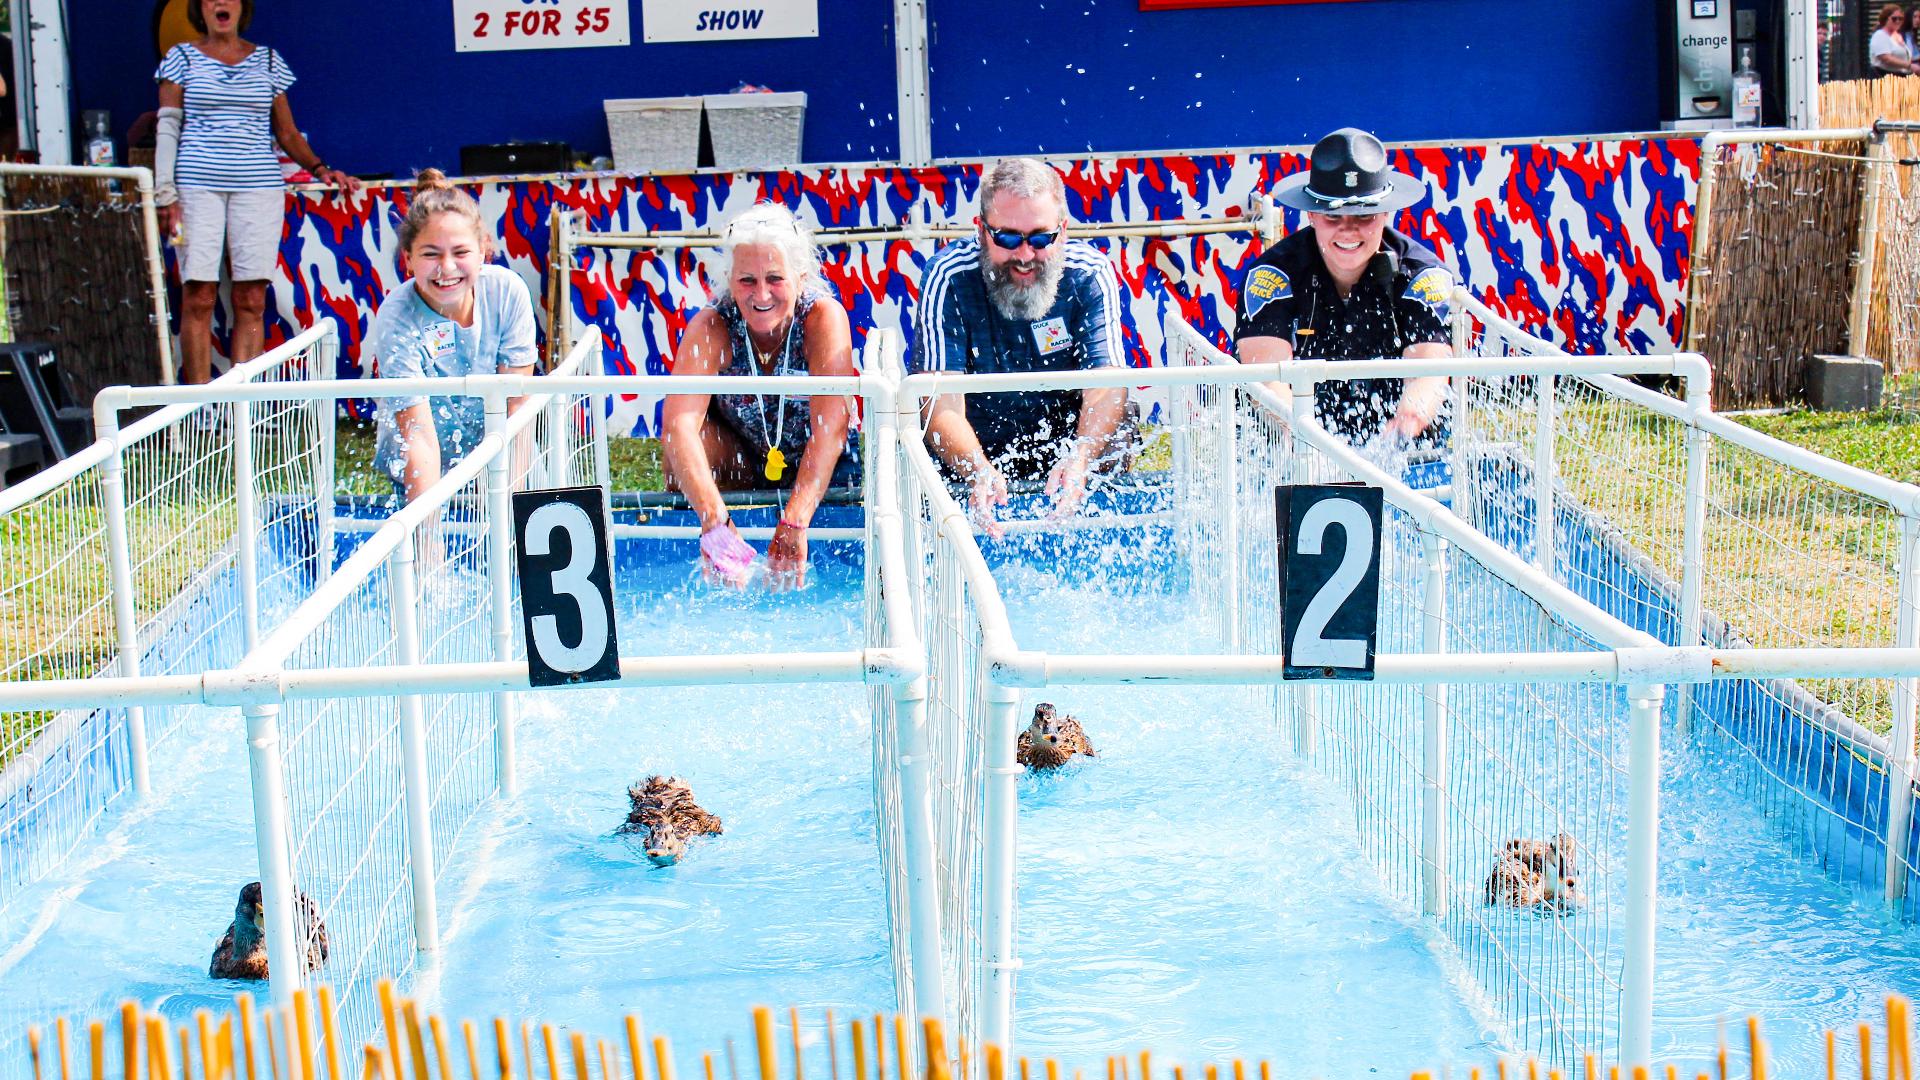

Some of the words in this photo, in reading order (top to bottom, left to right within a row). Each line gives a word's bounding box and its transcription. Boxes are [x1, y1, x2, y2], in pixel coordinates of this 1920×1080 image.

[473, 12, 490, 37] 2
[505, 9, 561, 36] FOR
[575, 7, 610, 35] $5
[696, 9, 763, 31] SHOW
[1682, 34, 1728, 49] change
[1254, 269, 1287, 291] INDIANA
[1254, 277, 1277, 291] STATE
[1248, 284, 1273, 299] POLICE
[1032, 321, 1049, 330] DUCK
[524, 501, 609, 674] 3
[1290, 497, 1374, 669] 2
